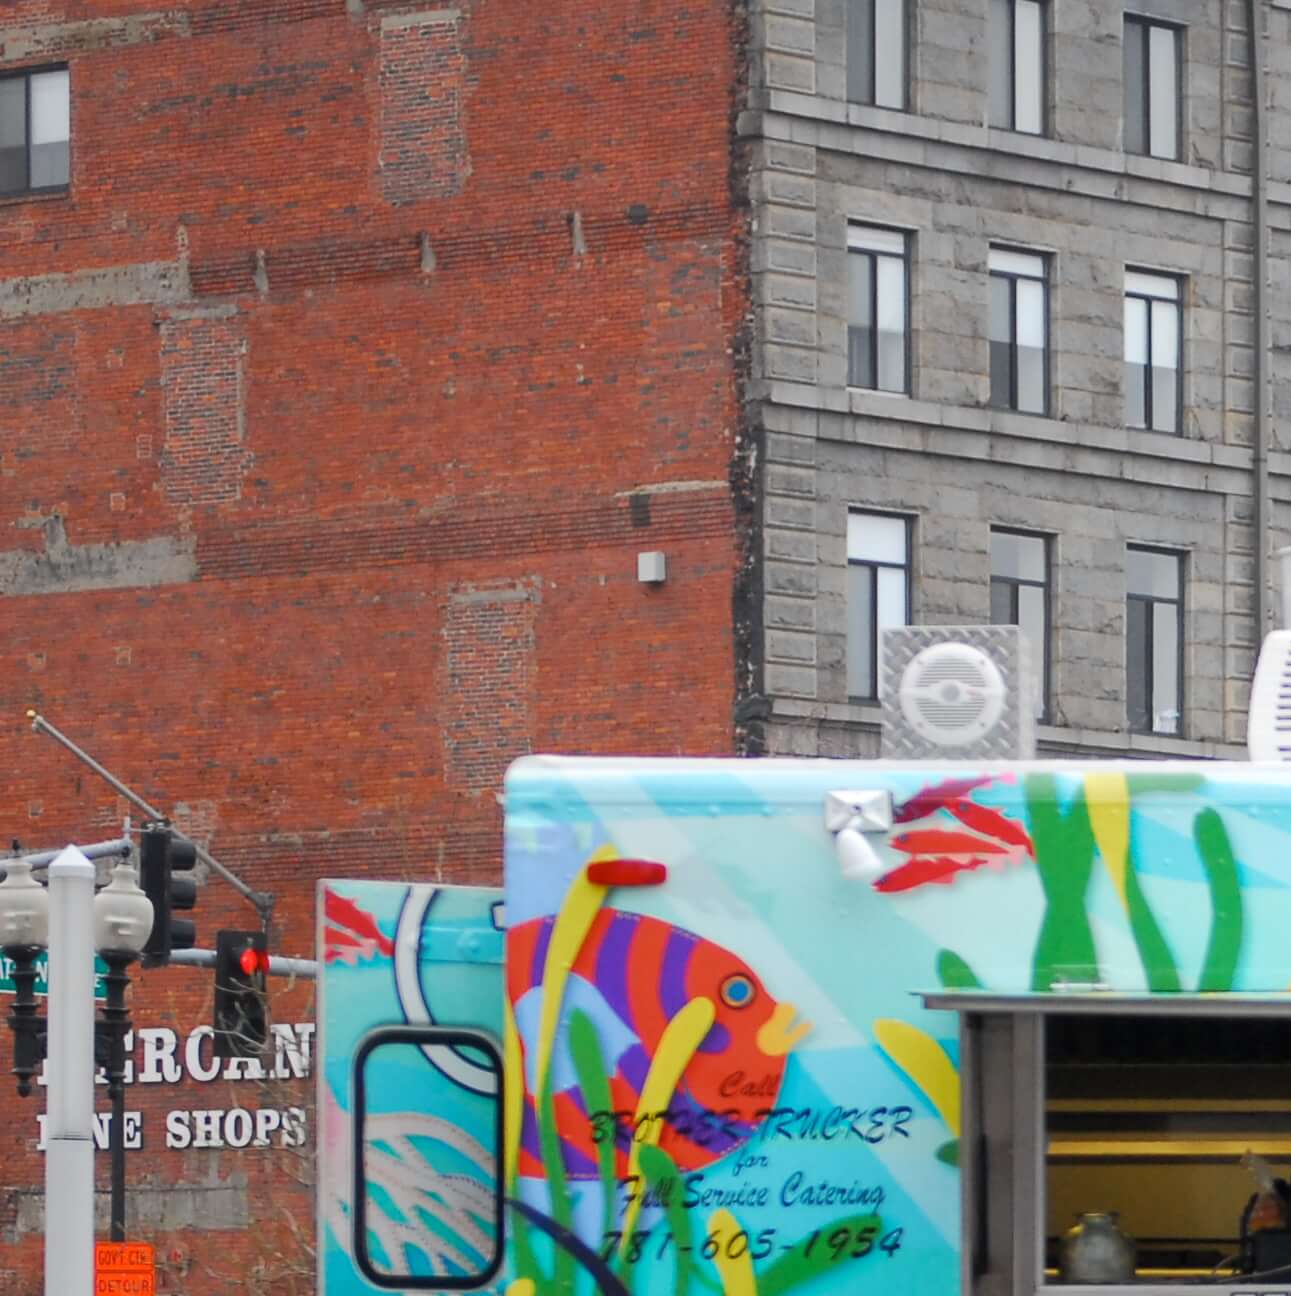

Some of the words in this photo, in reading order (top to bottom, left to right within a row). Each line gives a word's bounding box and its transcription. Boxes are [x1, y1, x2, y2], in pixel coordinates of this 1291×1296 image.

[718, 1071, 777, 1098] Call
[166, 1108, 306, 1149] SHOPS
[589, 1107, 744, 1144] BROTHER
[754, 1105, 913, 1144] TRUCKER
[733, 1151, 769, 1175] for
[617, 1176, 673, 1217] Full
[682, 1174, 768, 1208] Service
[779, 1171, 886, 1216] Catering
[600, 1226, 904, 1264] 781-605-1954
[98, 1279, 150, 1293] DETOUR
